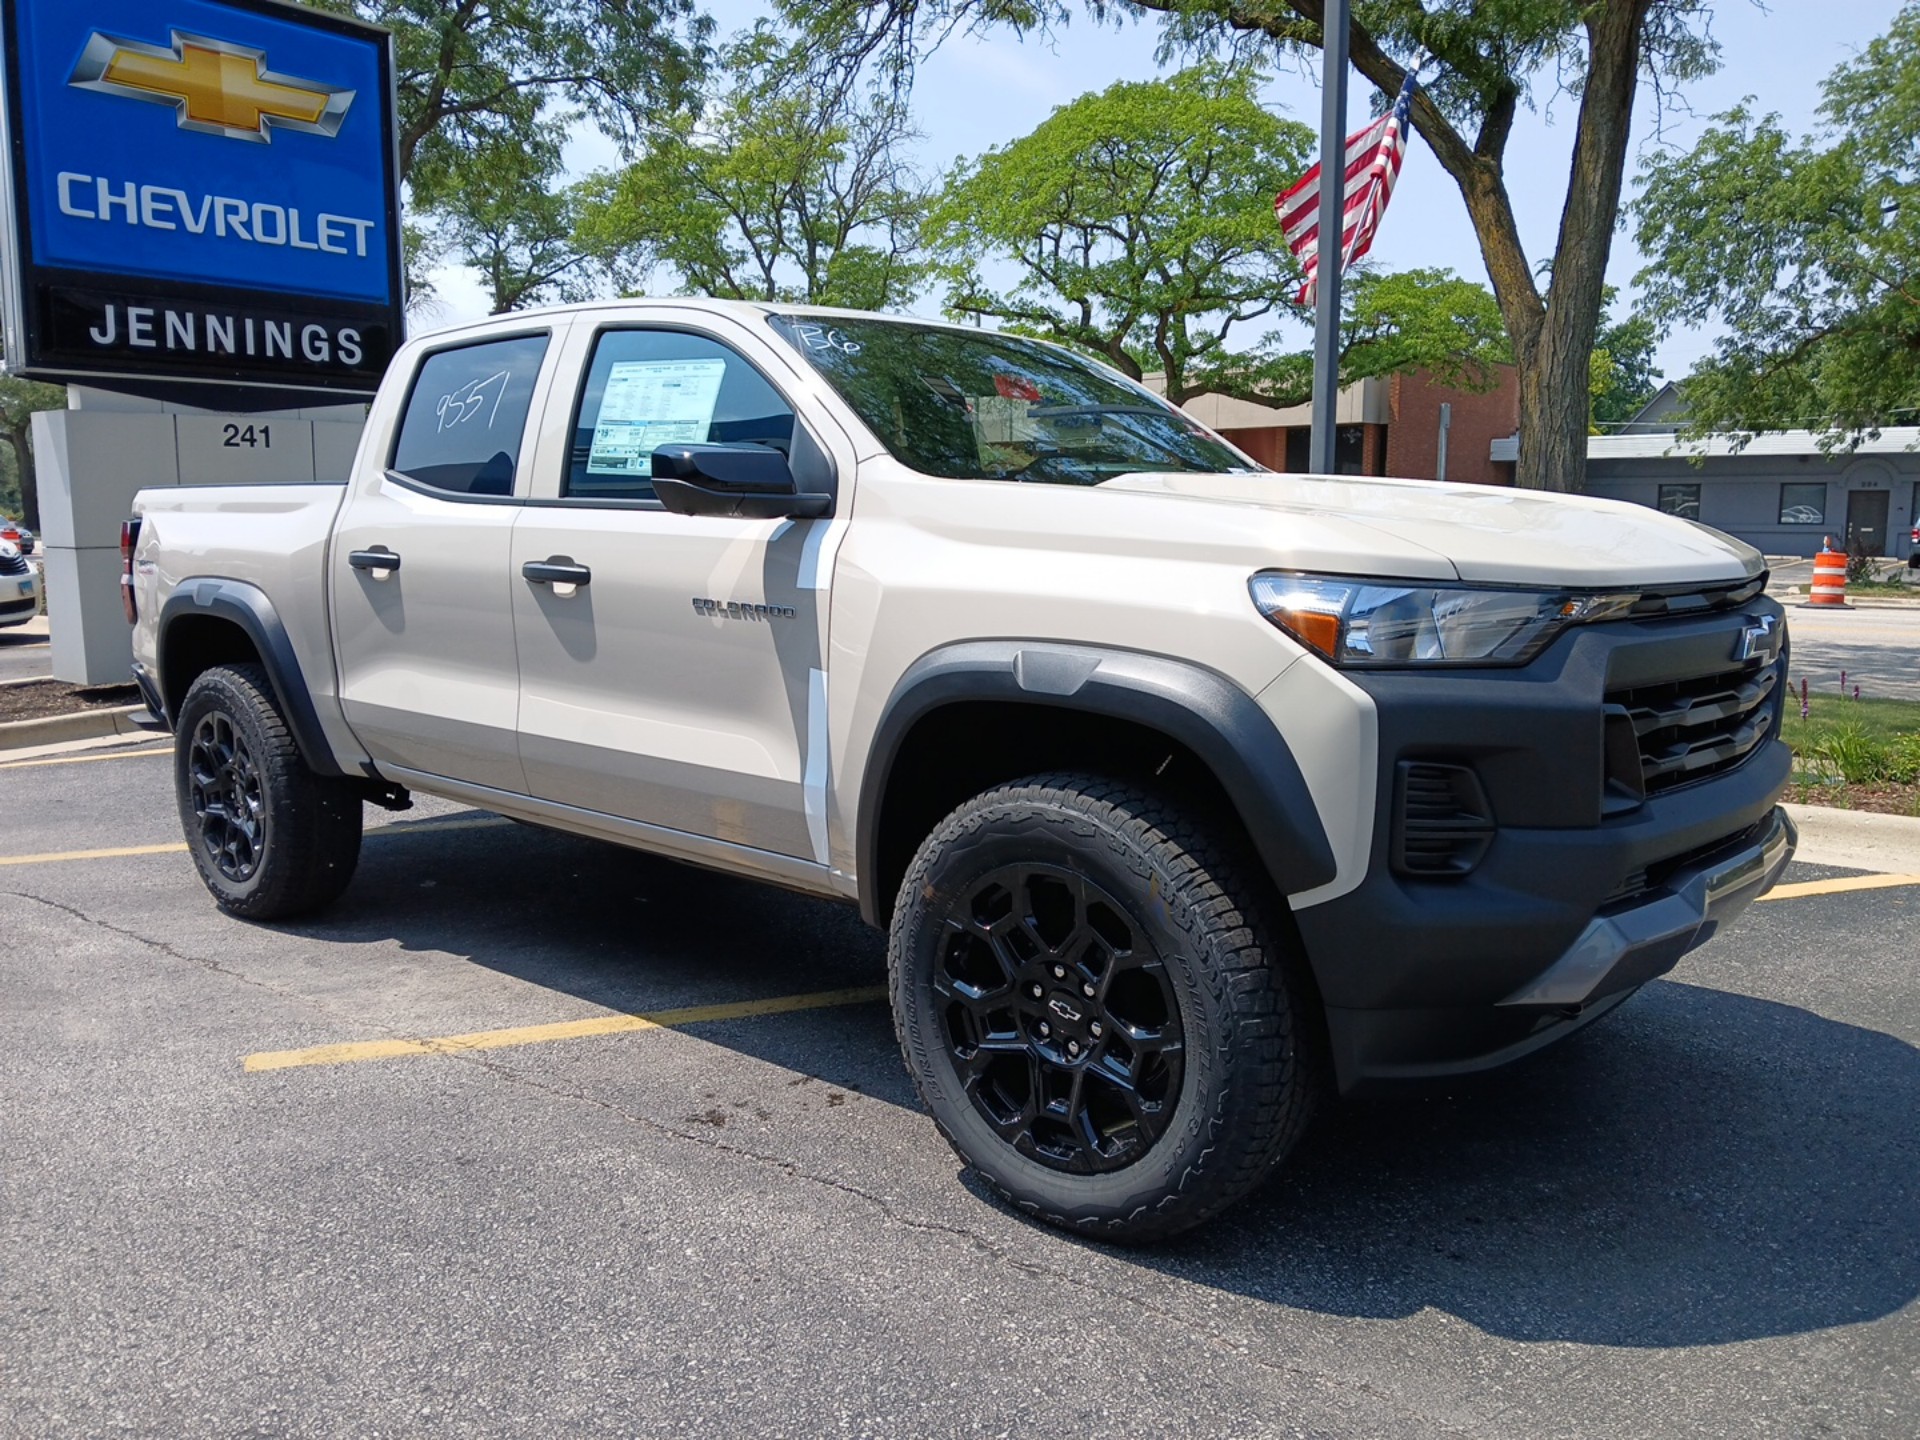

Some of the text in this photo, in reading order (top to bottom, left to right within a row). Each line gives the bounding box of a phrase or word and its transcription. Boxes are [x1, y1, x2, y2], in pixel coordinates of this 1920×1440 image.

[57, 171, 375, 257] CHEVROLET
[89, 304, 363, 365] JENNINGS
[222, 423, 270, 448] 241
[692, 598, 797, 618] COLORADO
